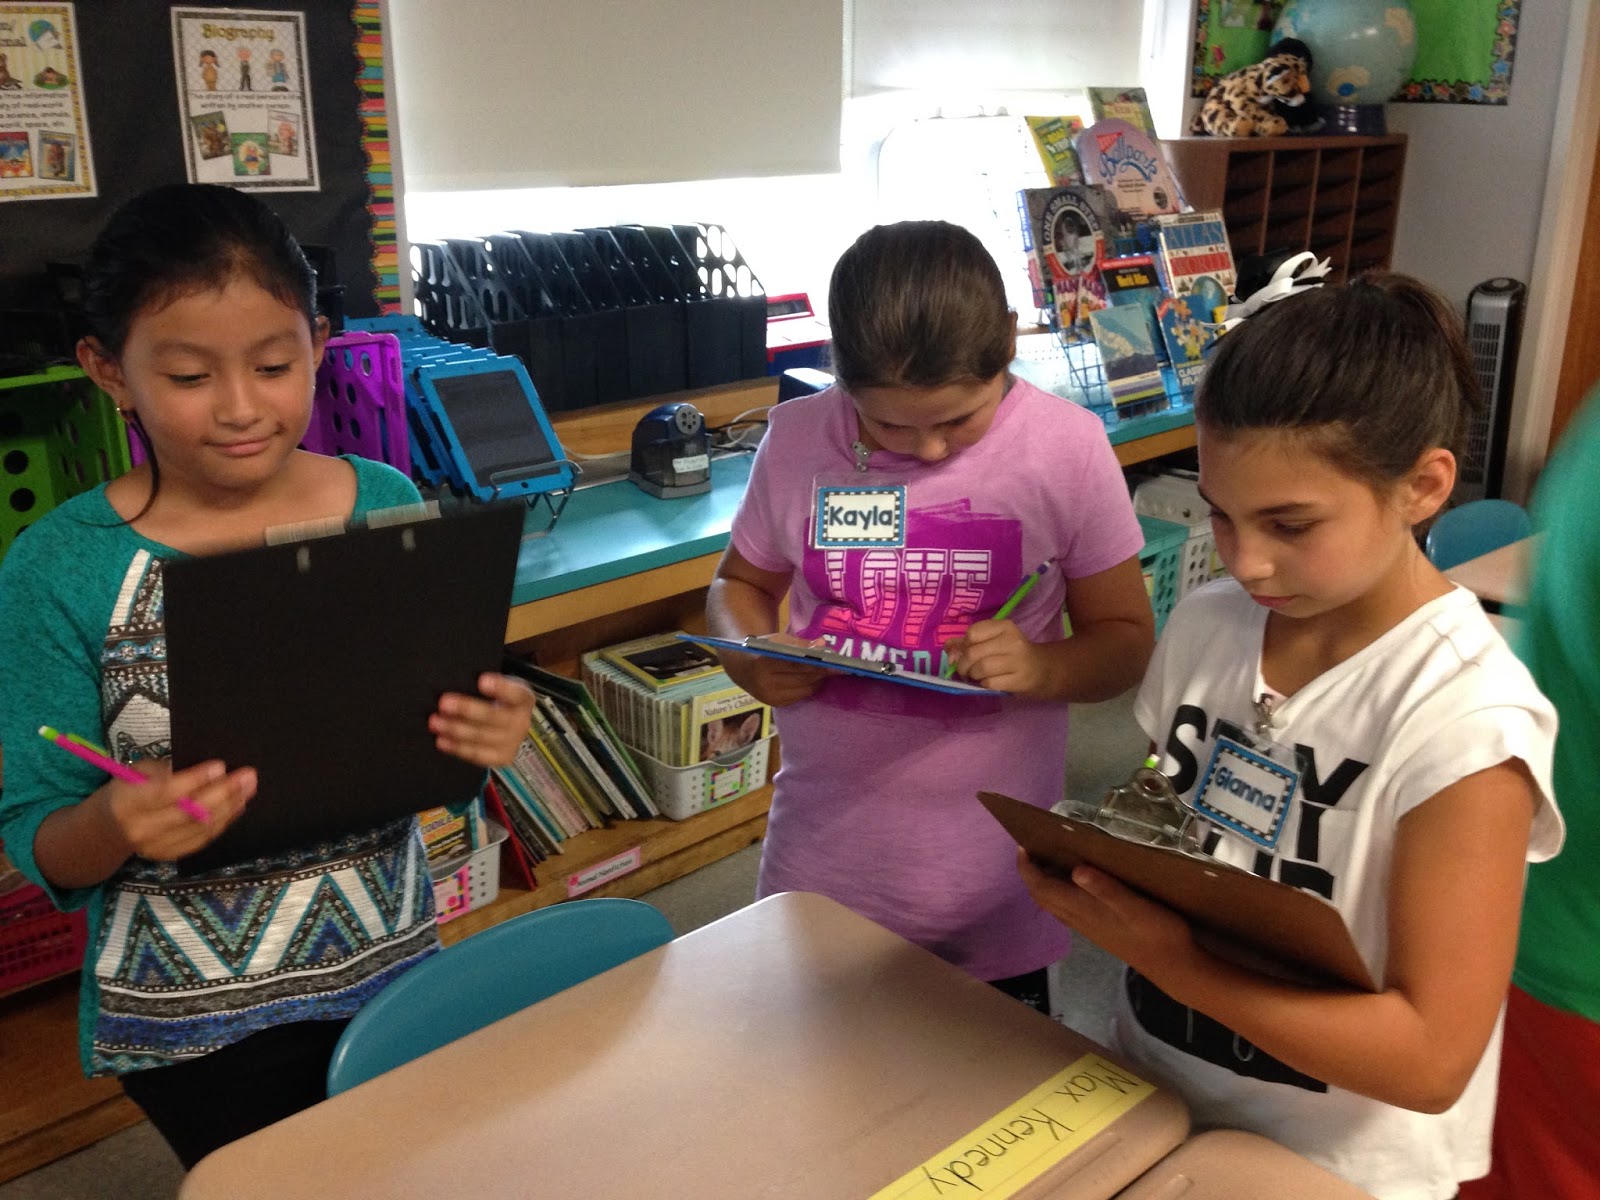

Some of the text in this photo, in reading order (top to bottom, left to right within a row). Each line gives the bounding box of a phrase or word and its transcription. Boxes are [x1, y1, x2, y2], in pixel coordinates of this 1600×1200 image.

[202, 23, 276, 42] Biography
[1043, 211, 1055, 241] ONE
[1049, 193, 1081, 214] SMALL
[1165, 222, 1225, 249] ATLAS
[829, 506, 893, 530] Kayla
[1214, 767, 1277, 813] Gianna
[599, 857, 633, 876] Nonfiction
[921, 1063, 1139, 1195] Max Kennedy
